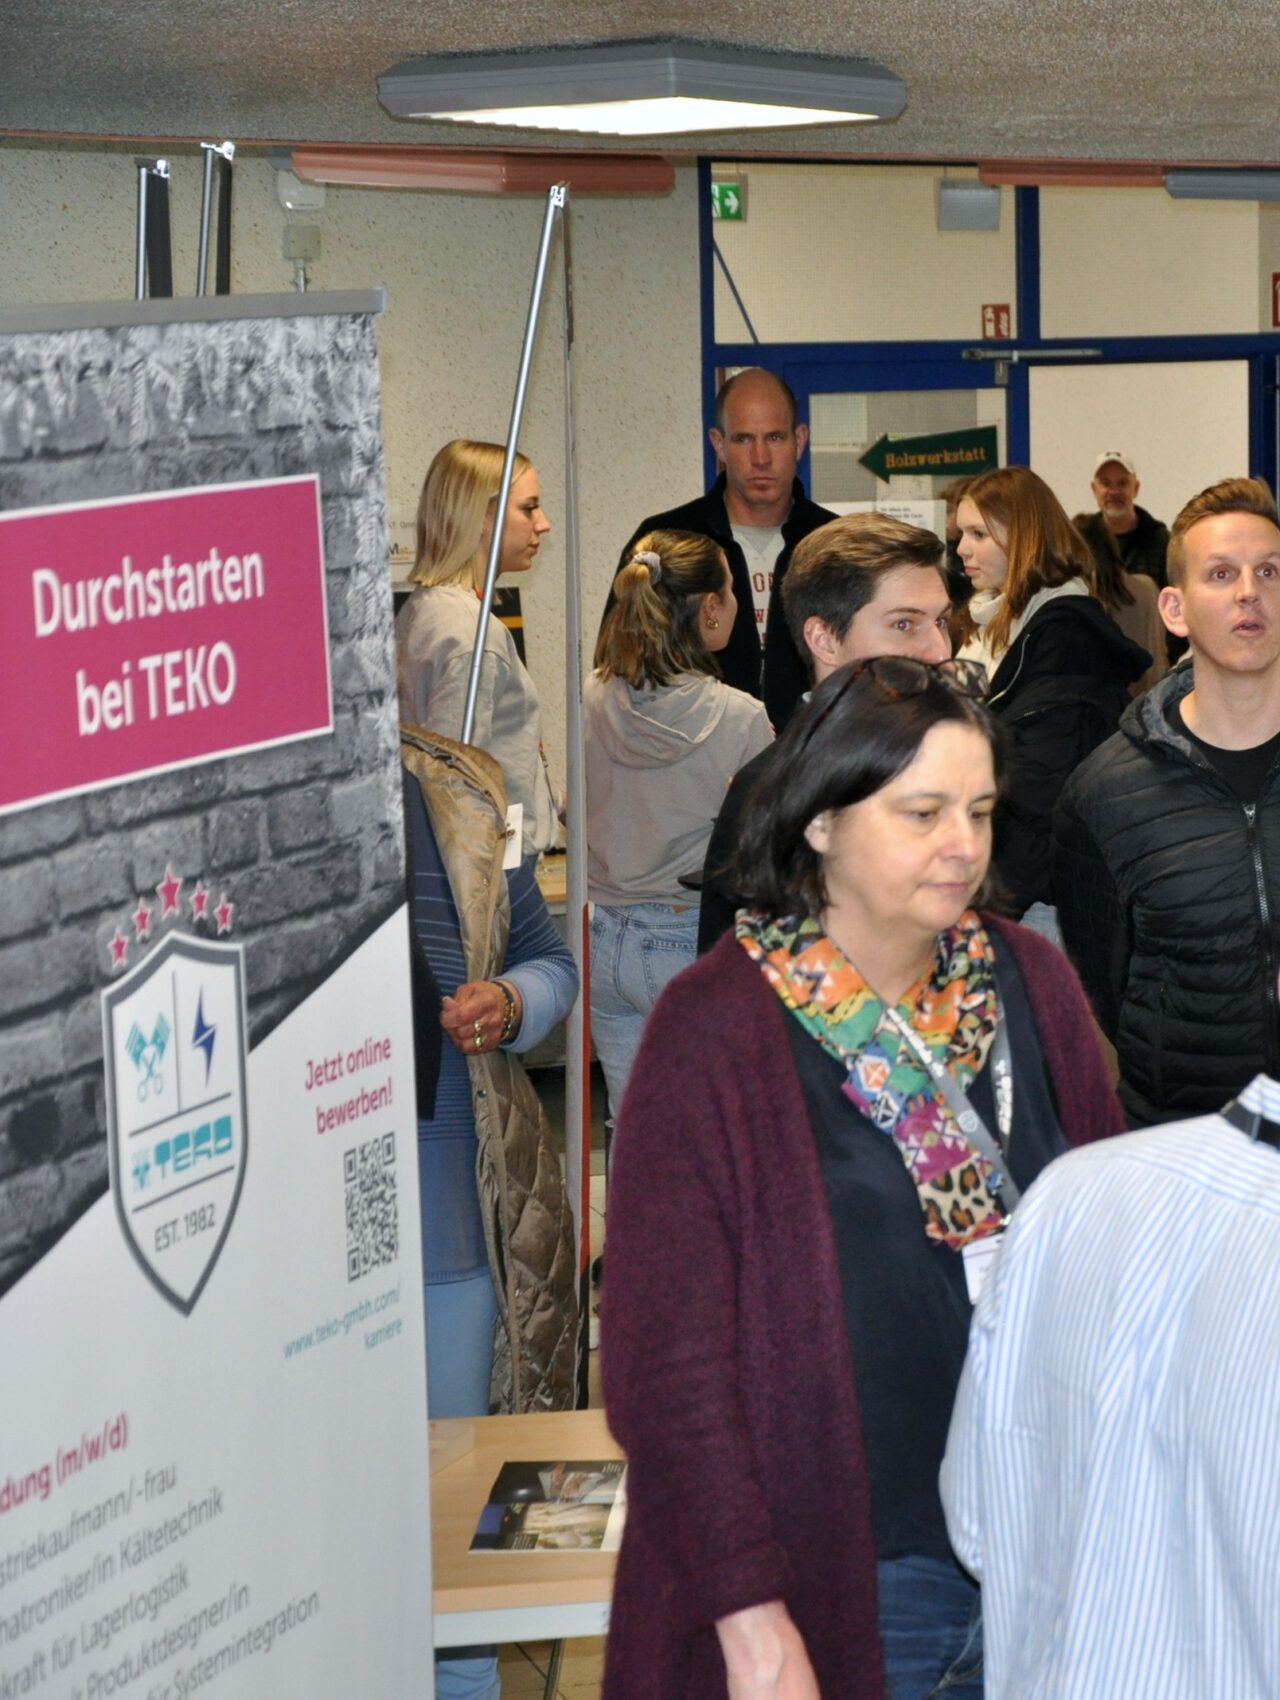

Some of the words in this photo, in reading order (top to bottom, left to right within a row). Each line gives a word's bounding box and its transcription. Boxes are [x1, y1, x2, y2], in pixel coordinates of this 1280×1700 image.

[885, 447, 986, 469] Holzwerkstatt
[32, 547, 265, 638] Durchstarten
[75, 661, 134, 736] bei
[138, 641, 237, 719] TEKO
[305, 1051, 344, 1091] Jetzt
[347, 1037, 391, 1074] online
[316, 1076, 393, 1135] bewerben!
[154, 1217, 182, 1252] EST.
[184, 1202, 216, 1238] 1982
[56, 1411, 128, 1486] (m/w/d)
[120, 1486, 223, 1573] Kältetechnik
[52, 1633, 77, 1674] für
[80, 1562, 189, 1655] Lagerlogistik
[174, 1591, 320, 1700] Systemintegration
